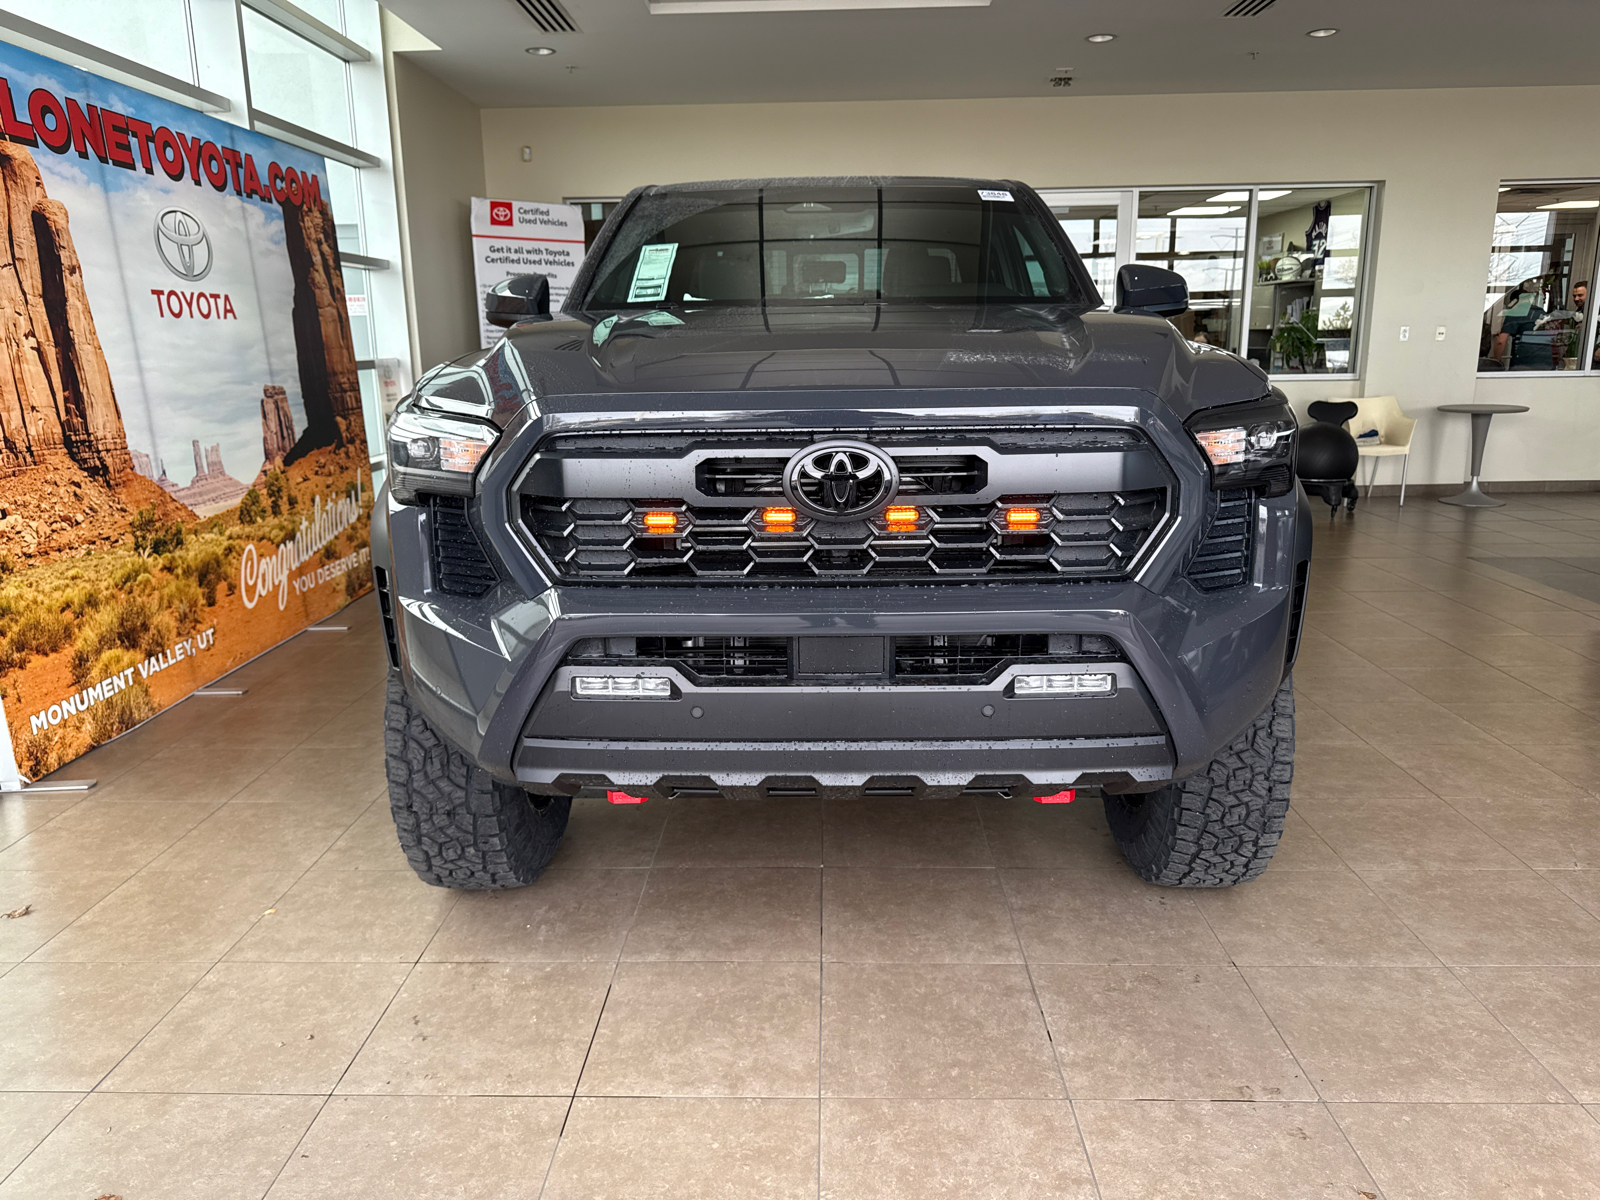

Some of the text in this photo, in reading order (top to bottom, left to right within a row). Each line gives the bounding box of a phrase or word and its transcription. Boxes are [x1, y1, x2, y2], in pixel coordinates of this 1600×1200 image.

[0, 76, 323, 213] LONETOYOTA.COM
[518, 207, 550, 217] Certified
[518, 216, 568, 227] Used Vehicles
[485, 255, 575, 267] Certified Used Vehicles
[489, 245, 570, 258] Get it all with Toyota
[151, 289, 238, 320] TOYOTA
[240, 467, 363, 611] Congratulations!
[292, 571, 316, 595] YOU
[316, 552, 358, 585] DESERVE
[29, 628, 216, 736] MONUMENT VALLEY, UT
